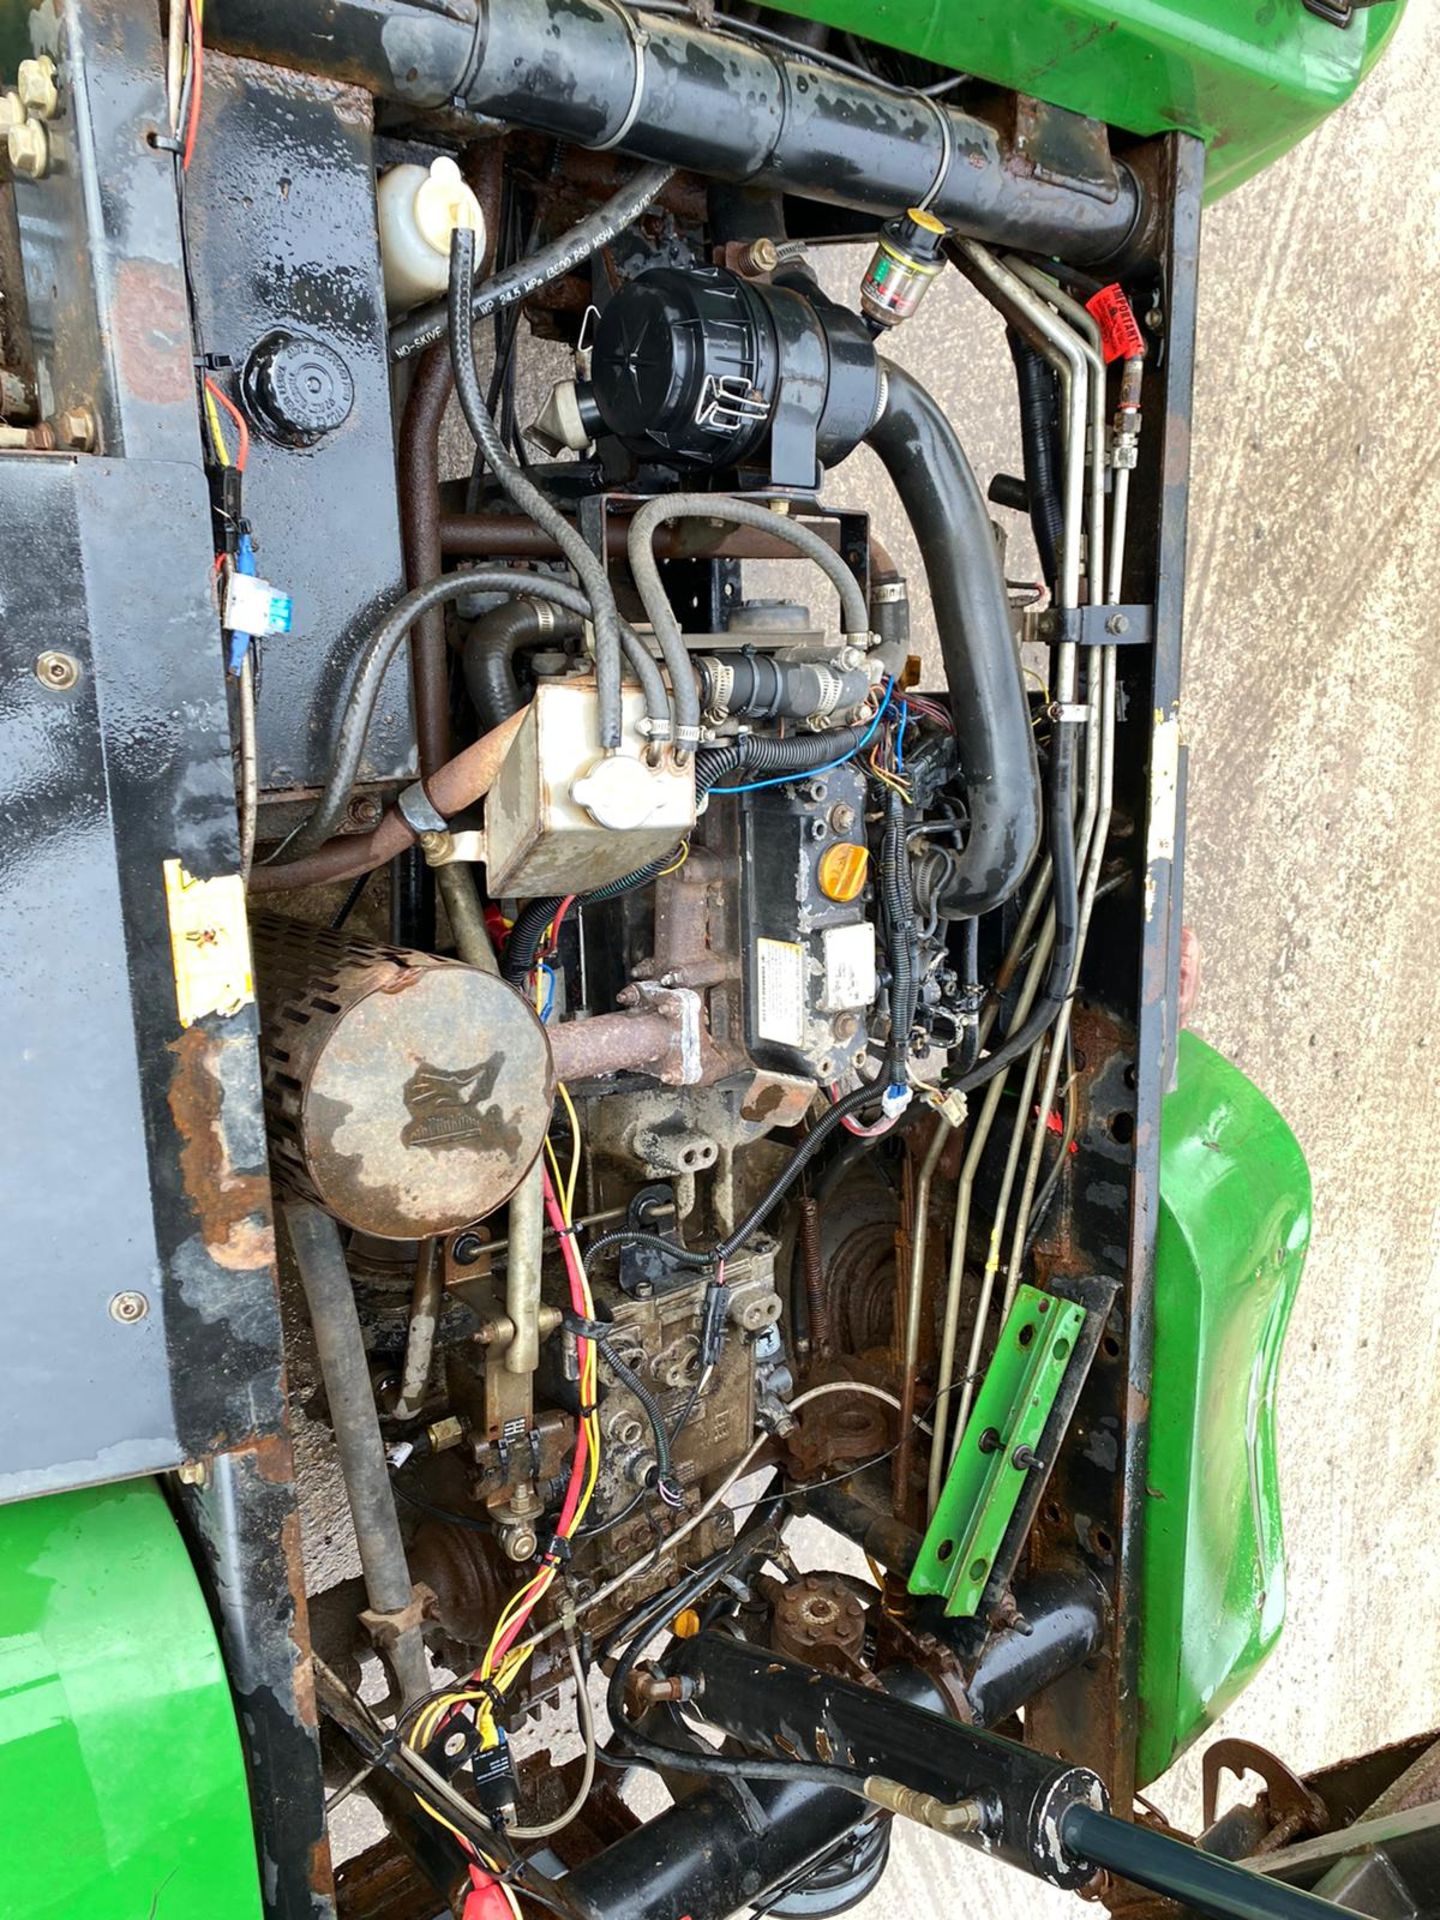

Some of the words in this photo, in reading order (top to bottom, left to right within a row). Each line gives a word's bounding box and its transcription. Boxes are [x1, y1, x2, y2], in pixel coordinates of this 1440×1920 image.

[395, 326, 443, 358] NO-SKIVE
[479, 300, 494, 315] WP
[499, 286, 521, 305] 24.5
[524, 278, 543, 293] MPa
[546, 257, 571, 279] (3500
[592, 227, 614, 249] MSHA
[1112, 287, 1139, 342] IMPORTANT
